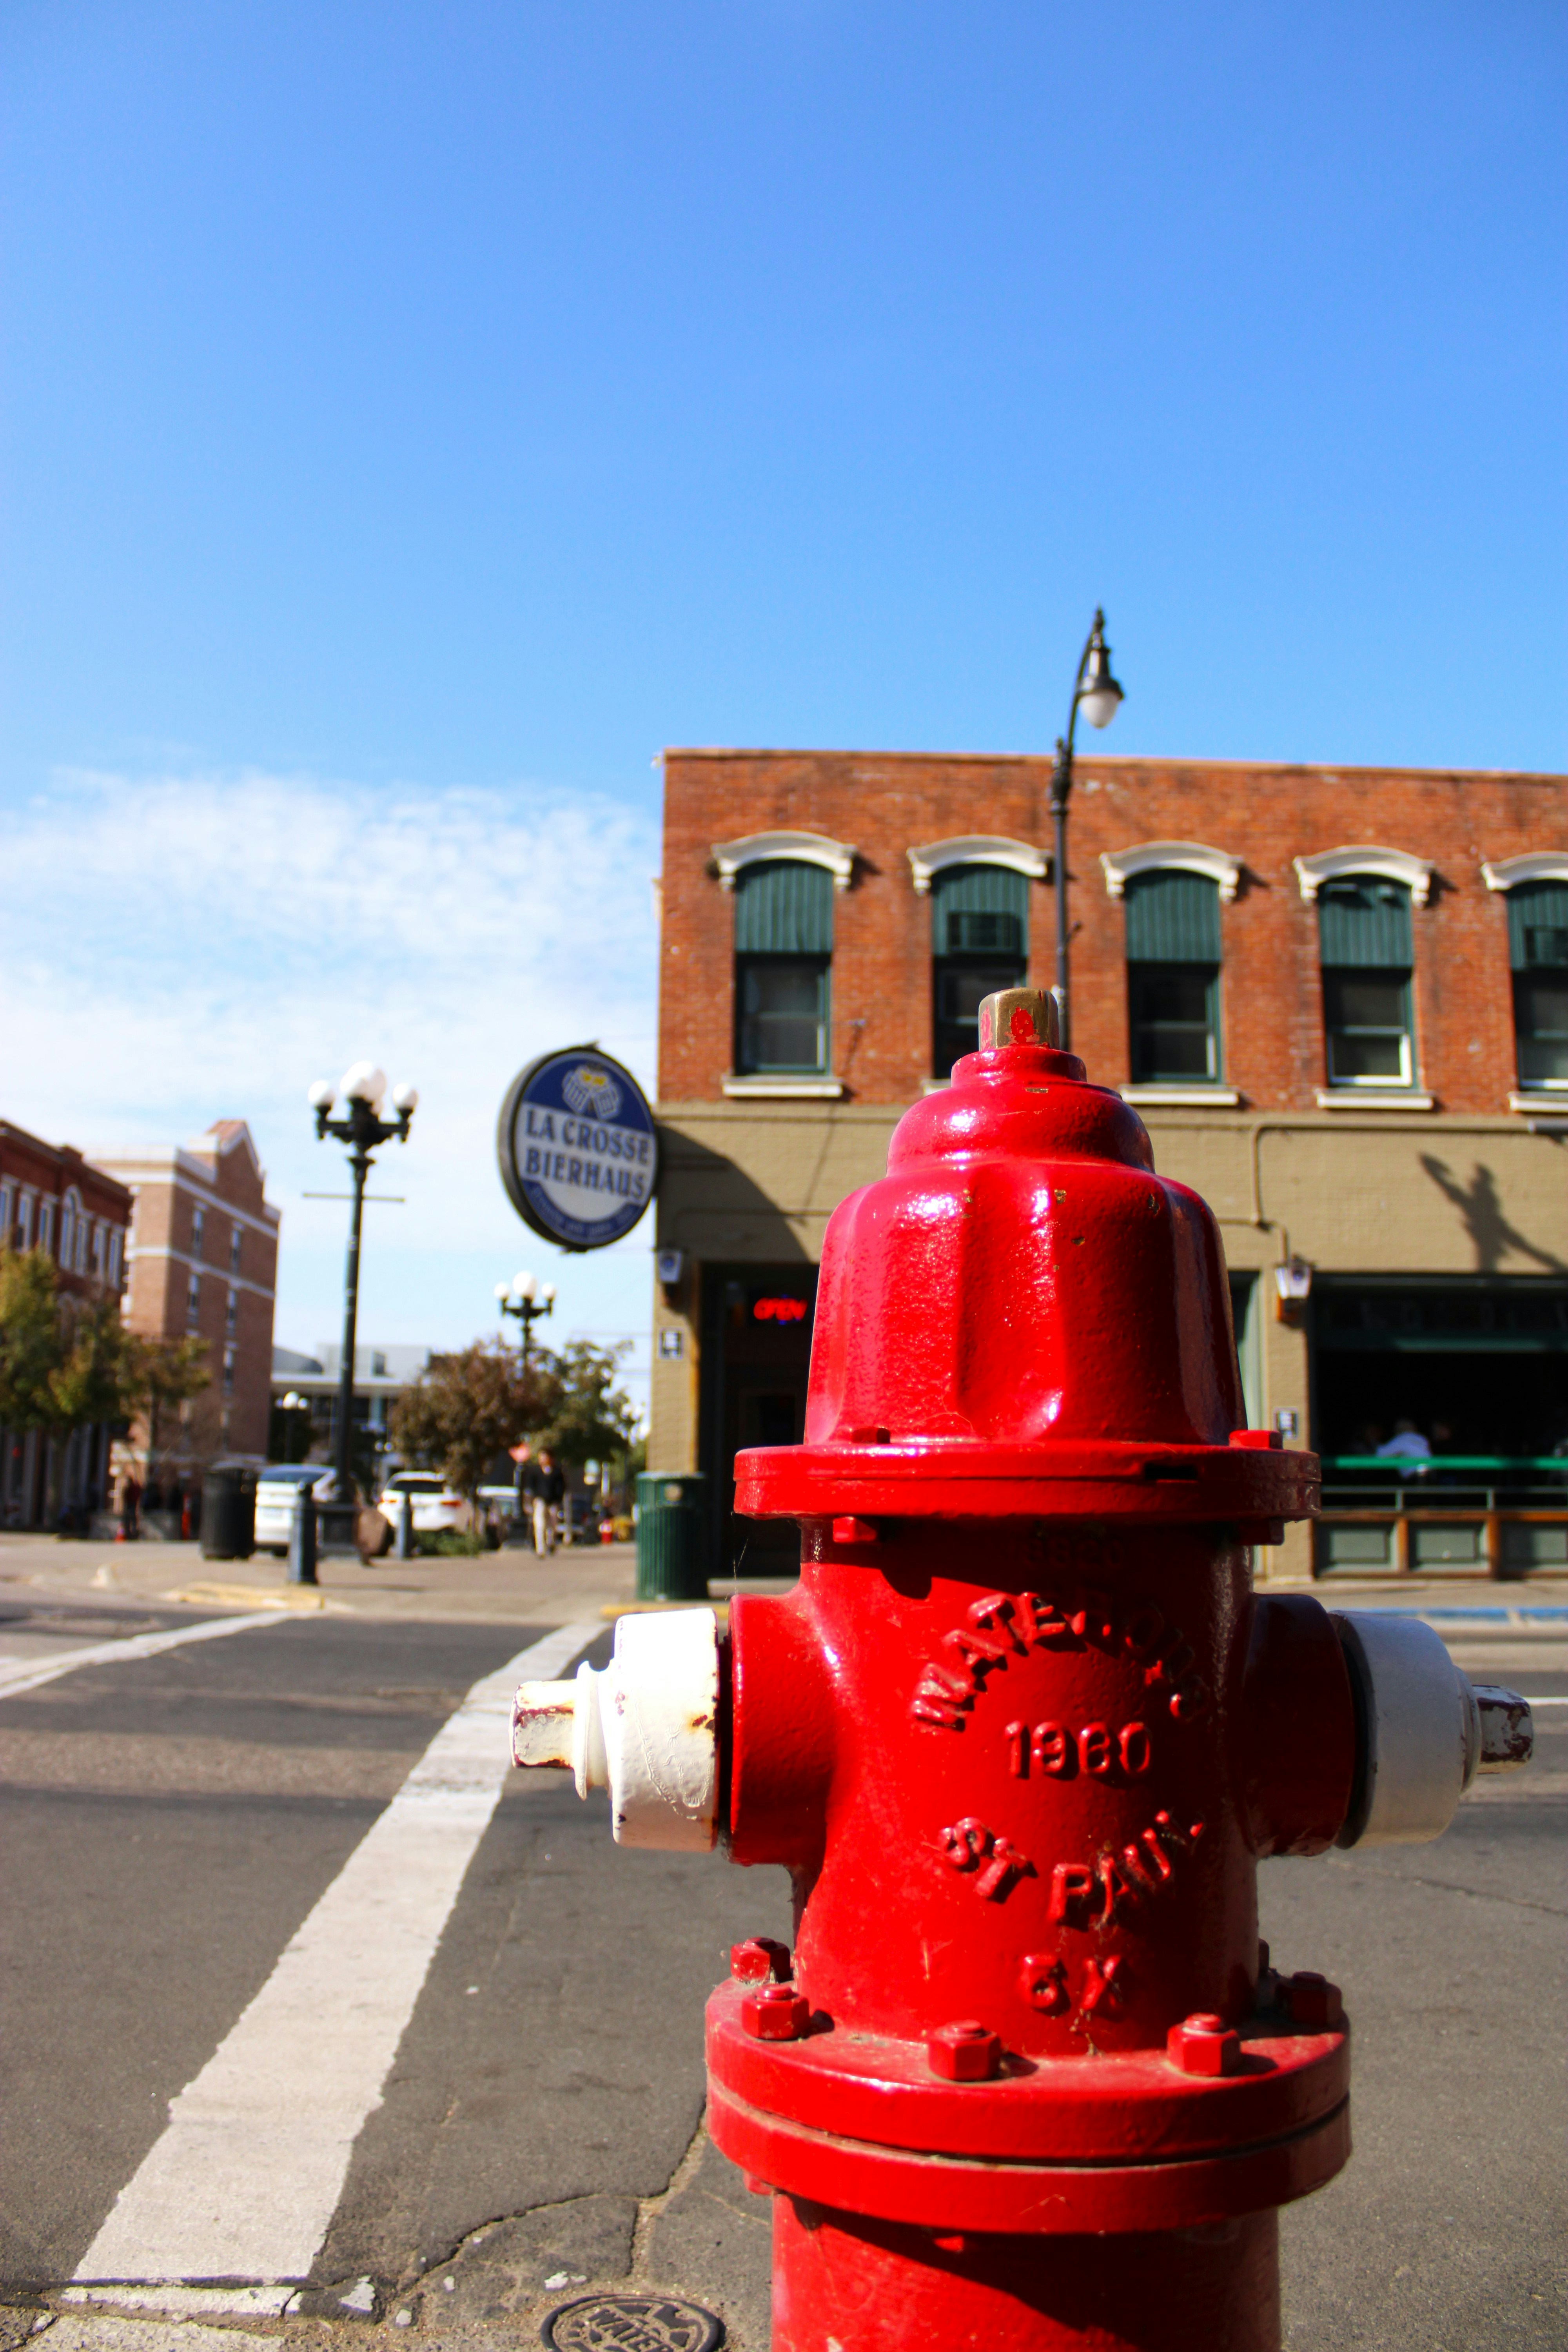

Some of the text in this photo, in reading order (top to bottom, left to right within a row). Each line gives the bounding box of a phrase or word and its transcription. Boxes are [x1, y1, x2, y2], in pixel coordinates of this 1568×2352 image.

[526, 1109, 649, 1167] LA CROSSE
[526, 1146, 646, 1200] BIERHAUS
